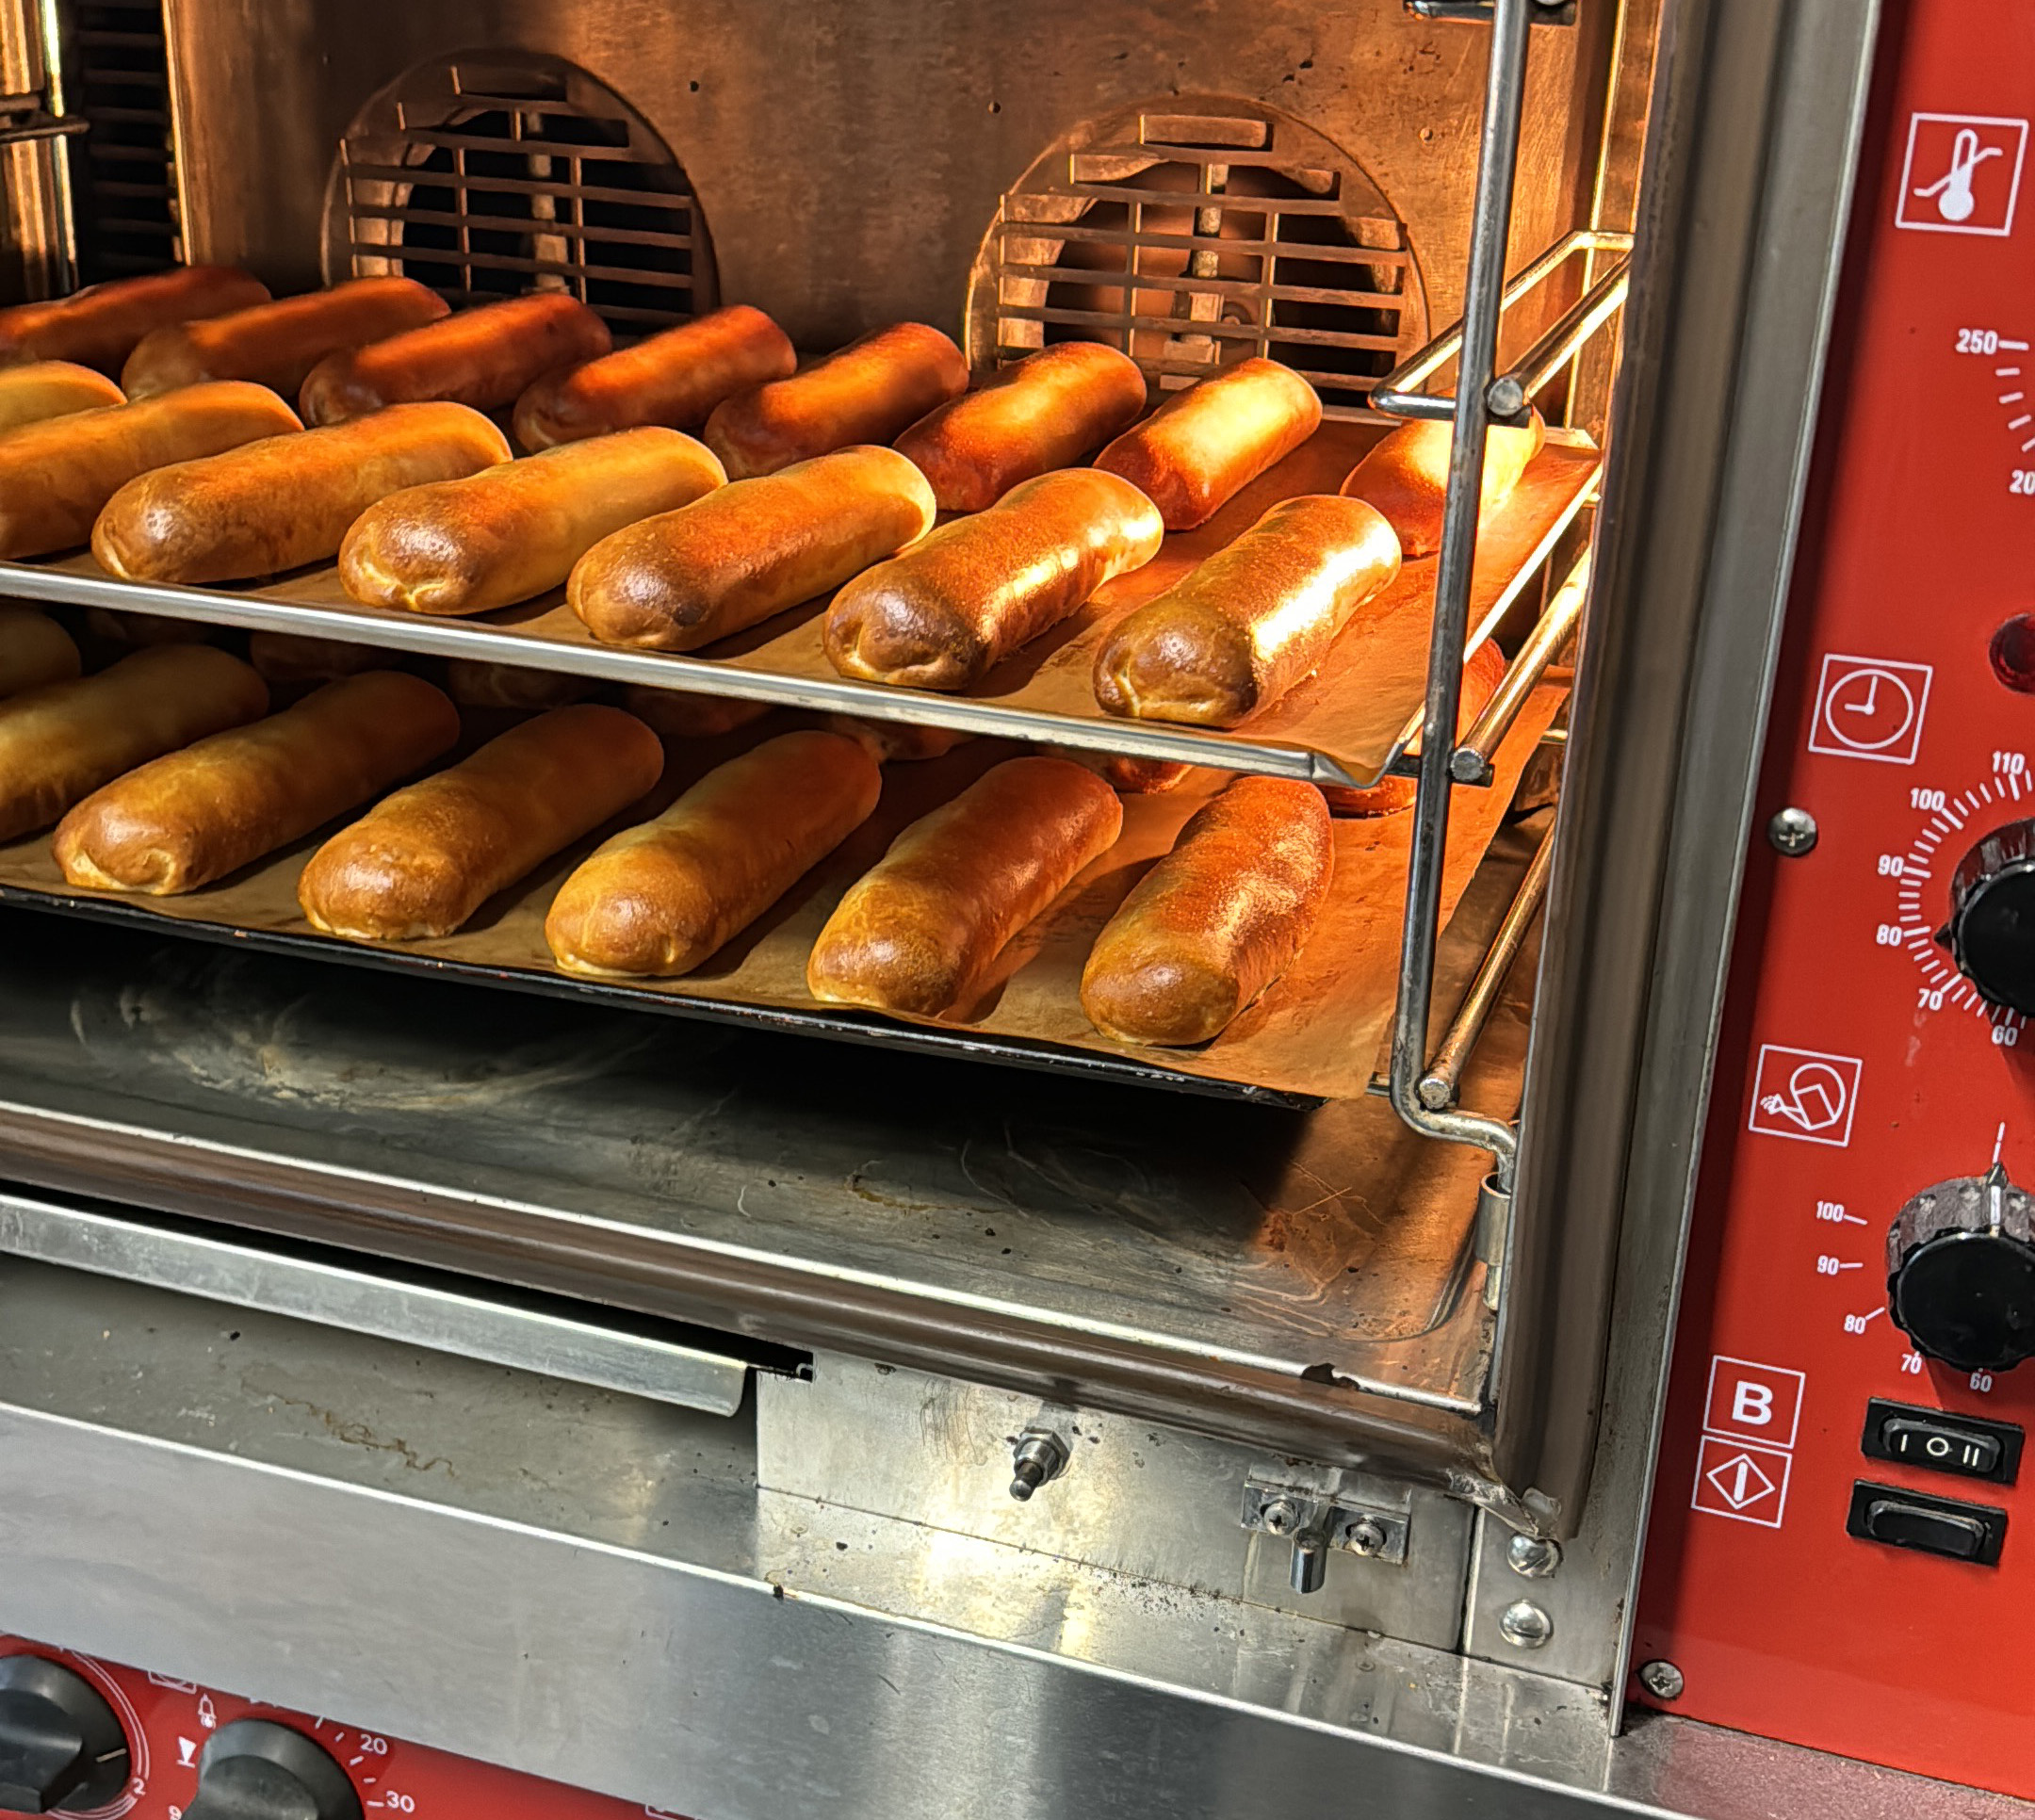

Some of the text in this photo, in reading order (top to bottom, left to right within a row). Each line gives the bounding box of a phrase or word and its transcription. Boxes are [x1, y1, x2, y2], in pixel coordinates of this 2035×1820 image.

[1955, 328, 1998, 354] 250
[1993, 751, 2025, 775] 110
[1911, 788, 1945, 812] 100
[1878, 854, 1904, 877] 90
[1876, 924, 1902, 946] 80
[1917, 988, 1943, 1011] 70
[1991, 1025, 2018, 1046] 60
[1816, 1201, 1844, 1223] 100
[1817, 1256, 1839, 1276] 90
[1844, 1315, 1866, 1334] 80
[1901, 1354, 1922, 1374] 70
[1969, 1373, 1993, 1393] 60
[1732, 1381, 1773, 1425] B
[360, 1733, 388, 1755] 20
[131, 1778, 146, 1796] 2
[385, 1791, 415, 1812] 30
